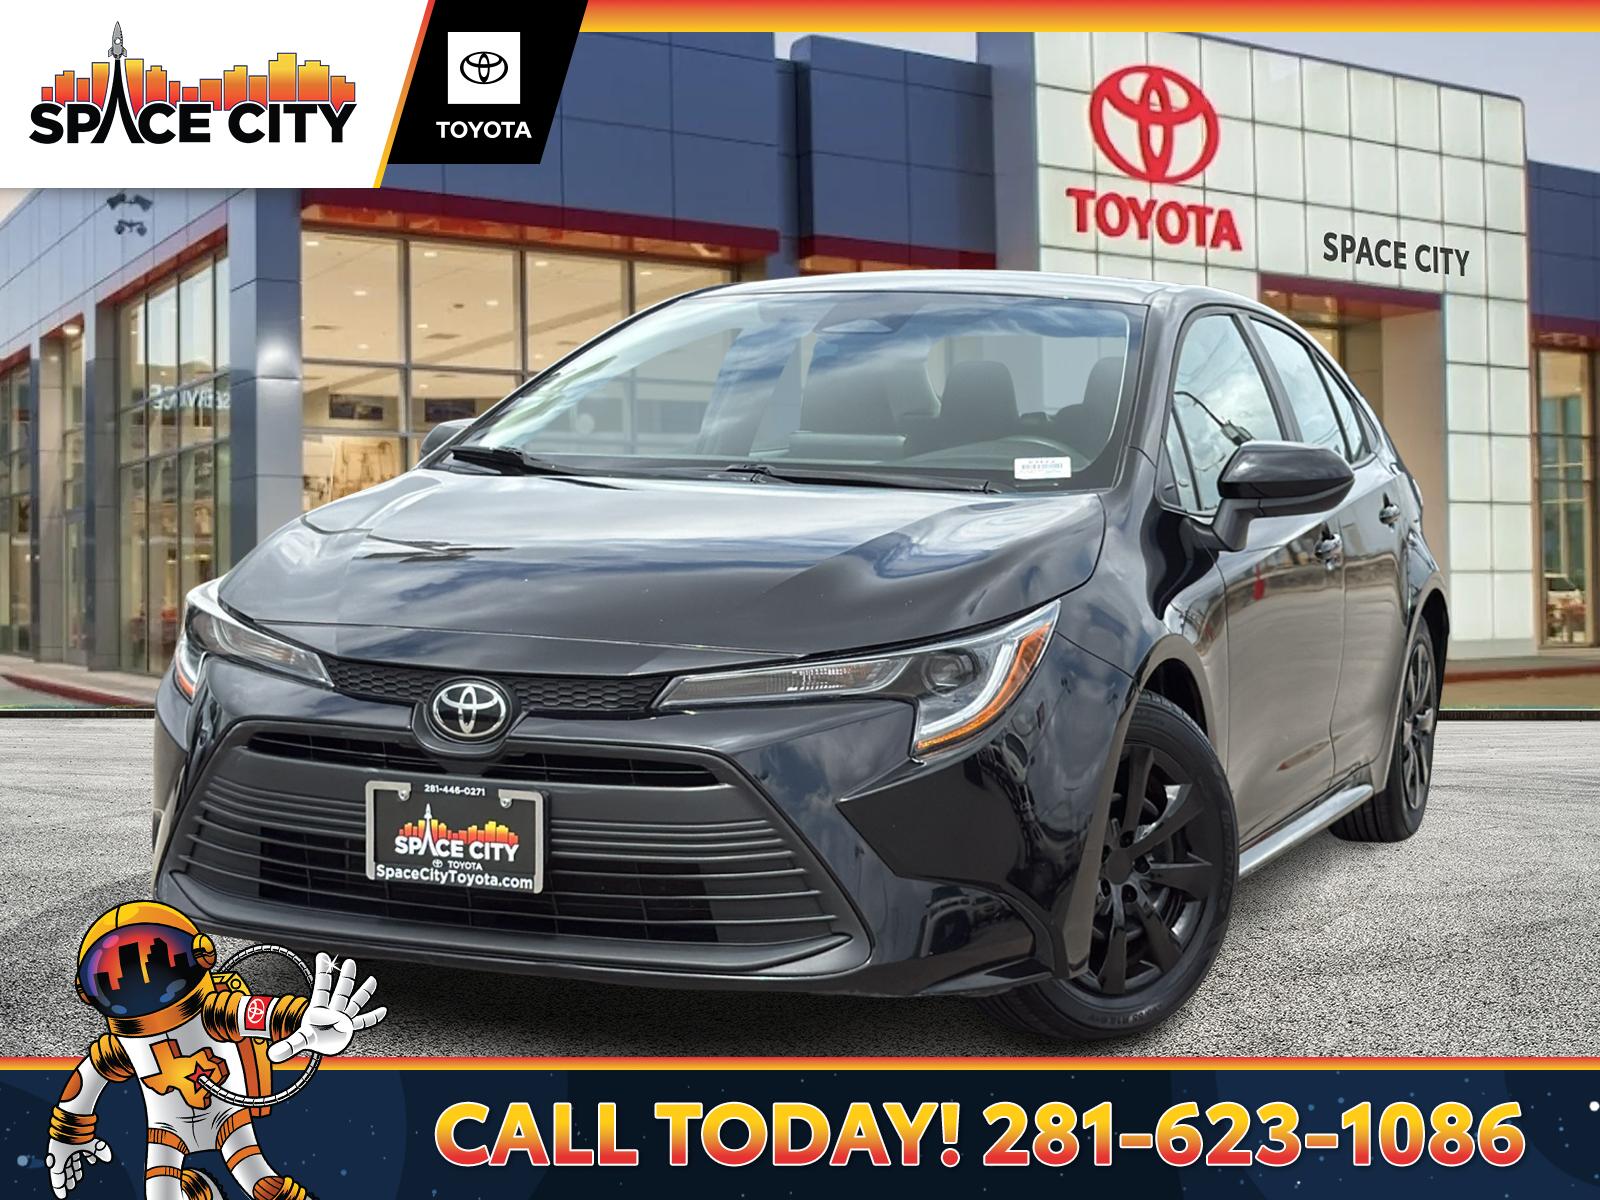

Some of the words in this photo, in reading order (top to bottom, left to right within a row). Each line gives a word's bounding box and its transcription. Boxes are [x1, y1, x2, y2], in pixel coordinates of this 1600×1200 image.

[1066, 187, 1242, 251] TOYOTA
[1323, 232, 1407, 270] SPACE
[1414, 244, 1470, 277] CITY
[395, 817, 465, 859] SPACE
[469, 841, 520, 862] CITY
[376, 864, 534, 890] SpaceCityToyota.com
[447, 860, 483, 871] TOYOTA
